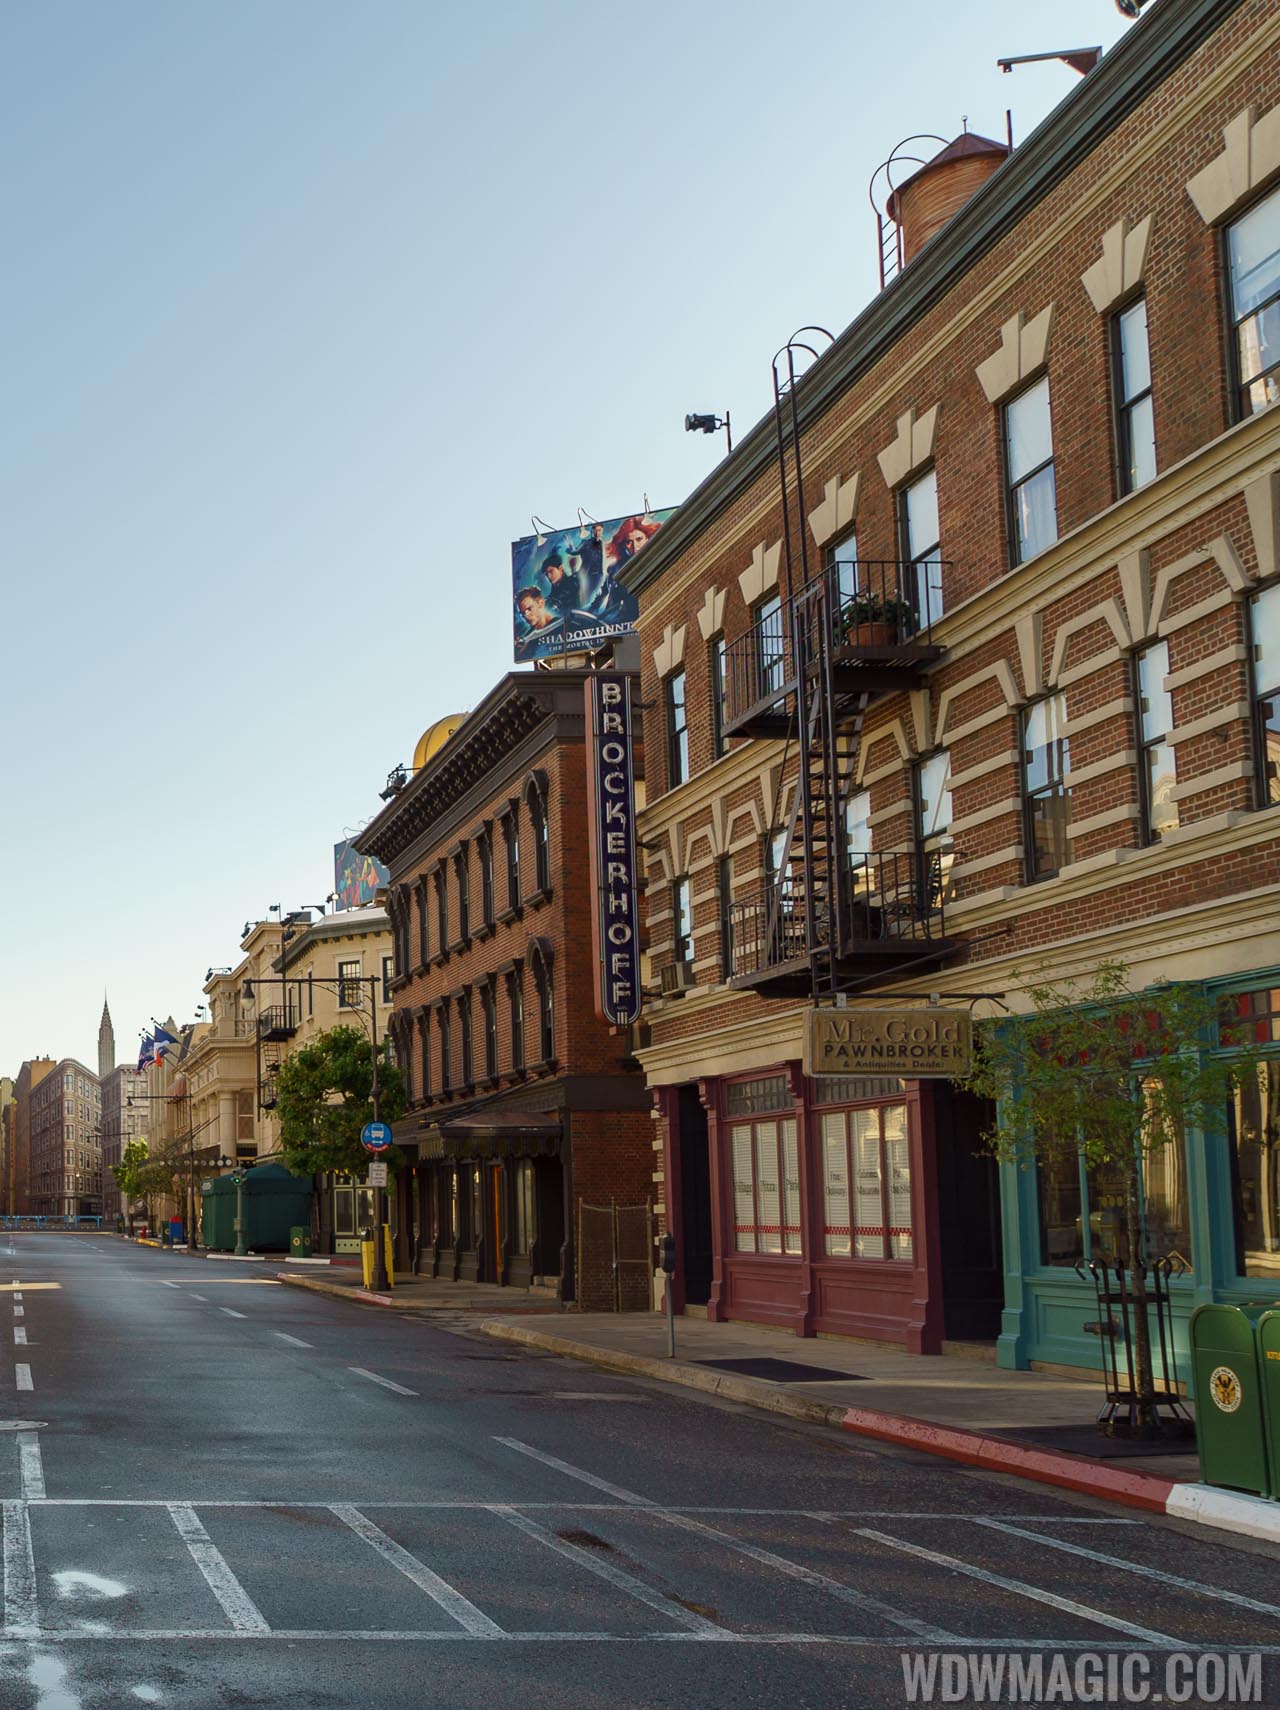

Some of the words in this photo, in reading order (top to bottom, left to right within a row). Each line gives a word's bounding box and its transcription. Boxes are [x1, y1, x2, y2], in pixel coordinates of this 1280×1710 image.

[538, 621, 634, 645] SHADOWHUNT
[601, 682, 631, 1005] BROCKERHOFF
[824, 1019, 880, 1043] Mr.
[885, 1019, 961, 1043] Gold
[824, 1044, 962, 1058] PAWNBROKER
